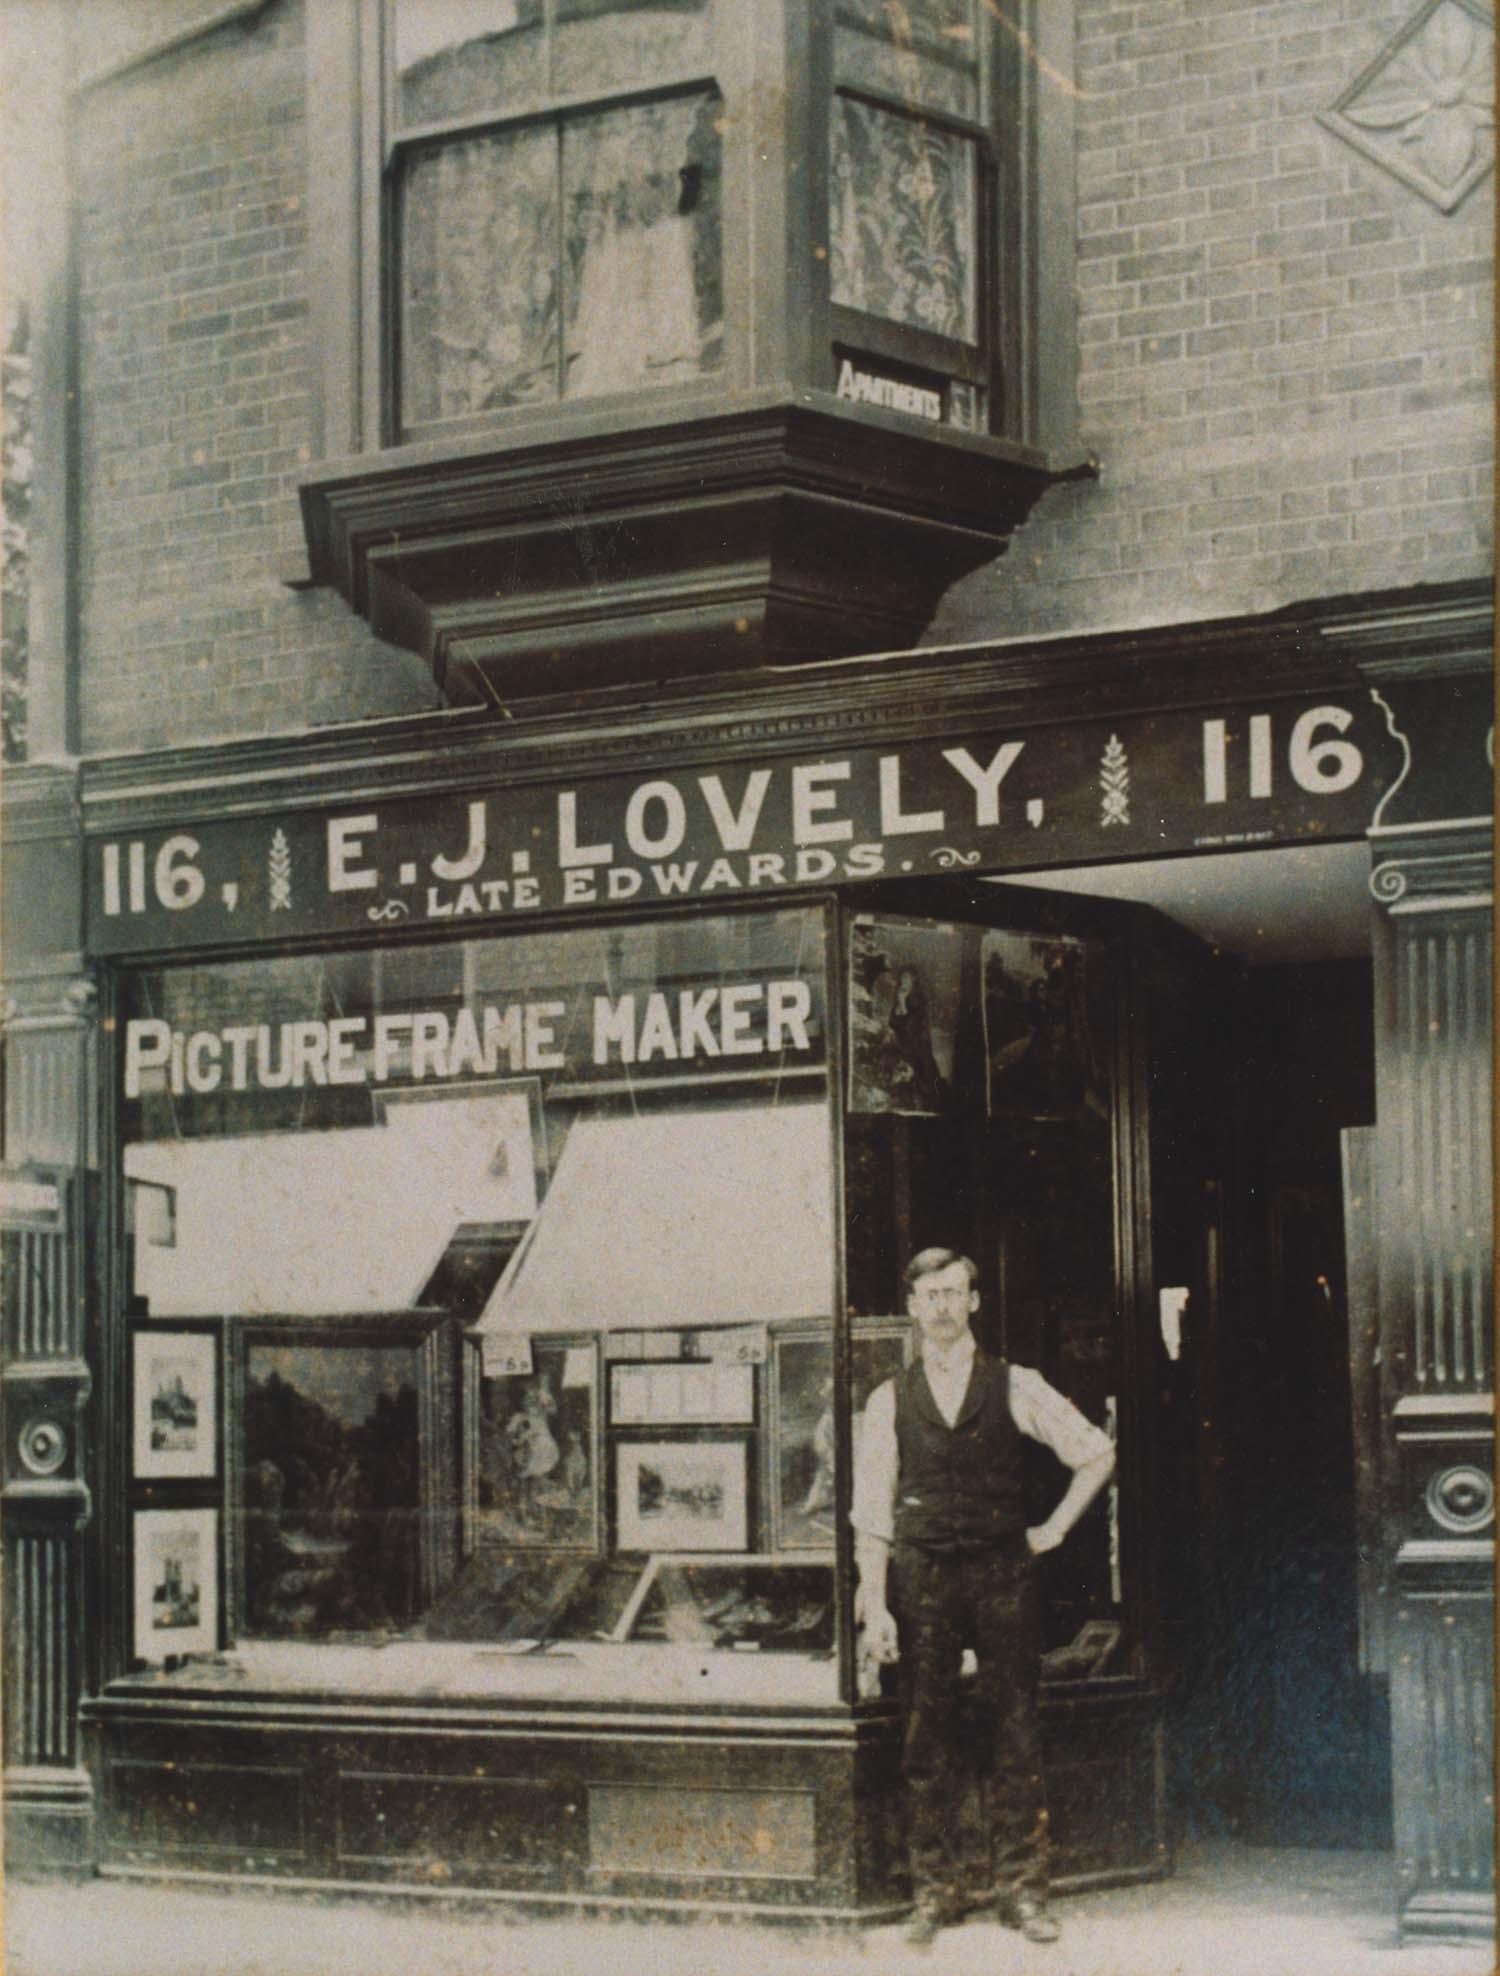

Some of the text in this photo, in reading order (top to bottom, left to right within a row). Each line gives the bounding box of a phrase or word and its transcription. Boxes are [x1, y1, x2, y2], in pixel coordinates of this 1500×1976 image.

[103, 835, 239, 915] 116,
[557, 741, 1044, 868] LOVELY,
[1203, 705, 1363, 804] 116
[426, 843, 913, 918] LATE EDWARDS.
[124, 980, 812, 1099] PICTURE FRAME MAKER
